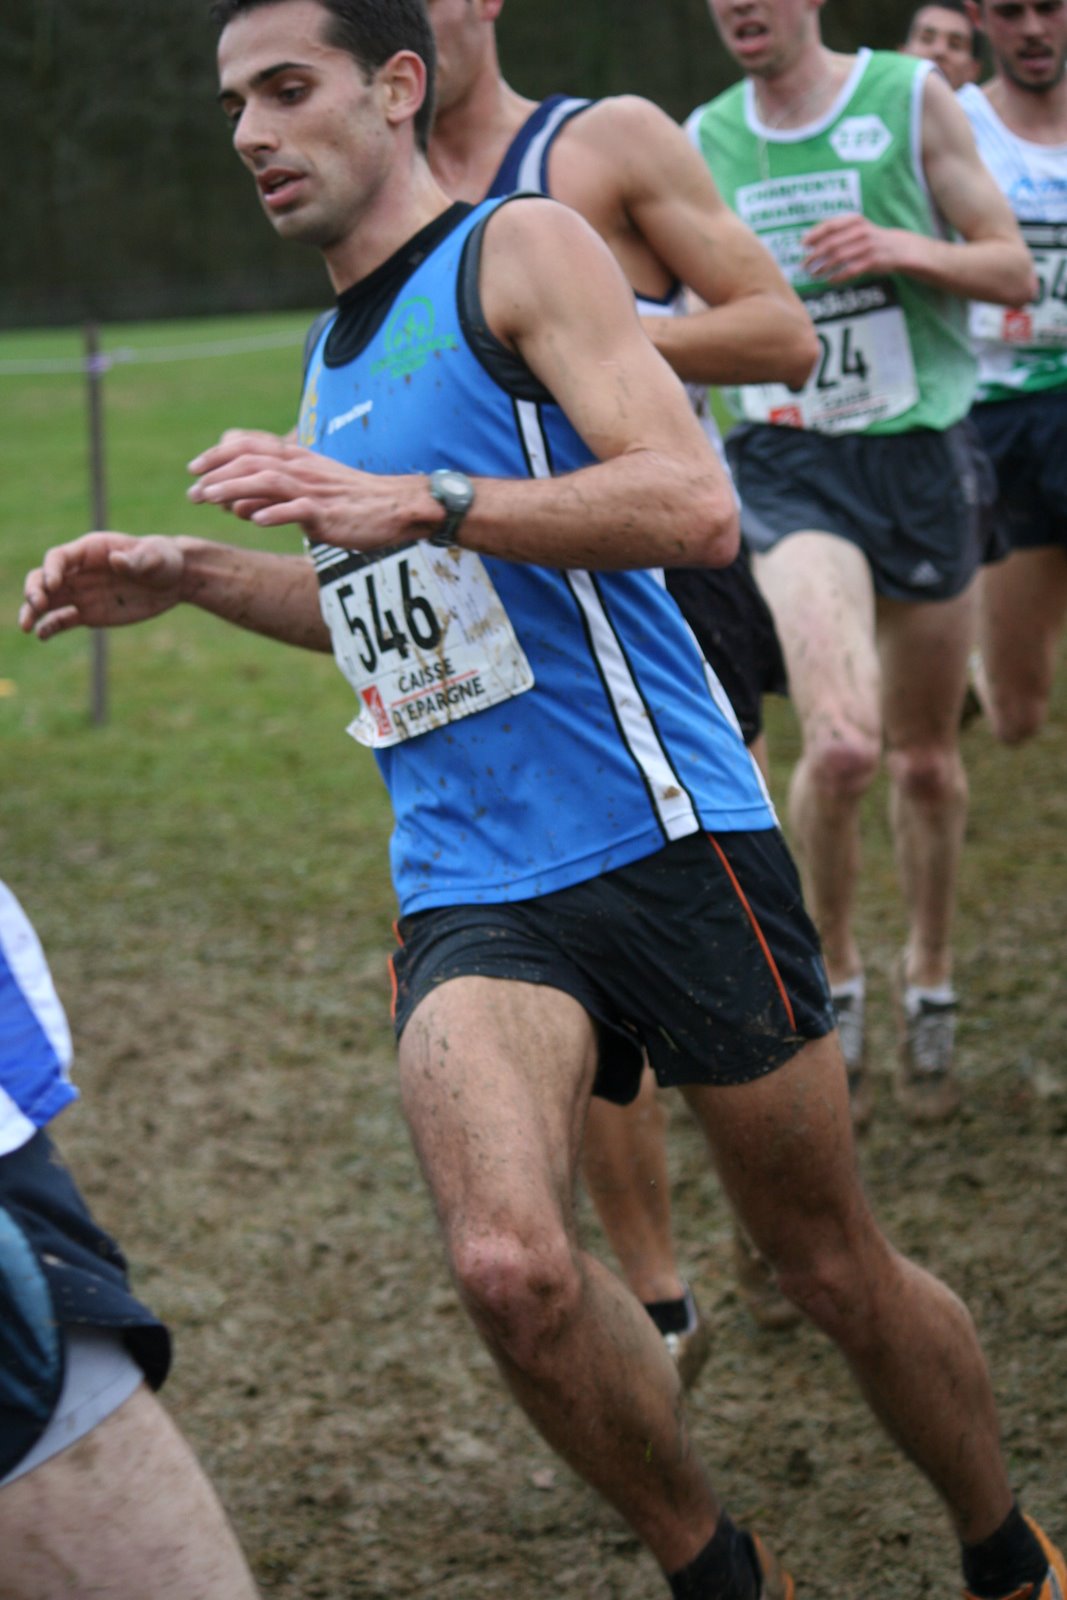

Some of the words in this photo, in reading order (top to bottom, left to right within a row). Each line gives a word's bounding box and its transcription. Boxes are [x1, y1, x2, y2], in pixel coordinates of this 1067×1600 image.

[816, 327, 868, 390] 24
[336, 558, 441, 674] 546
[391, 676, 486, 727] D'EPARGNE
[398, 657, 456, 693] CAISSE
